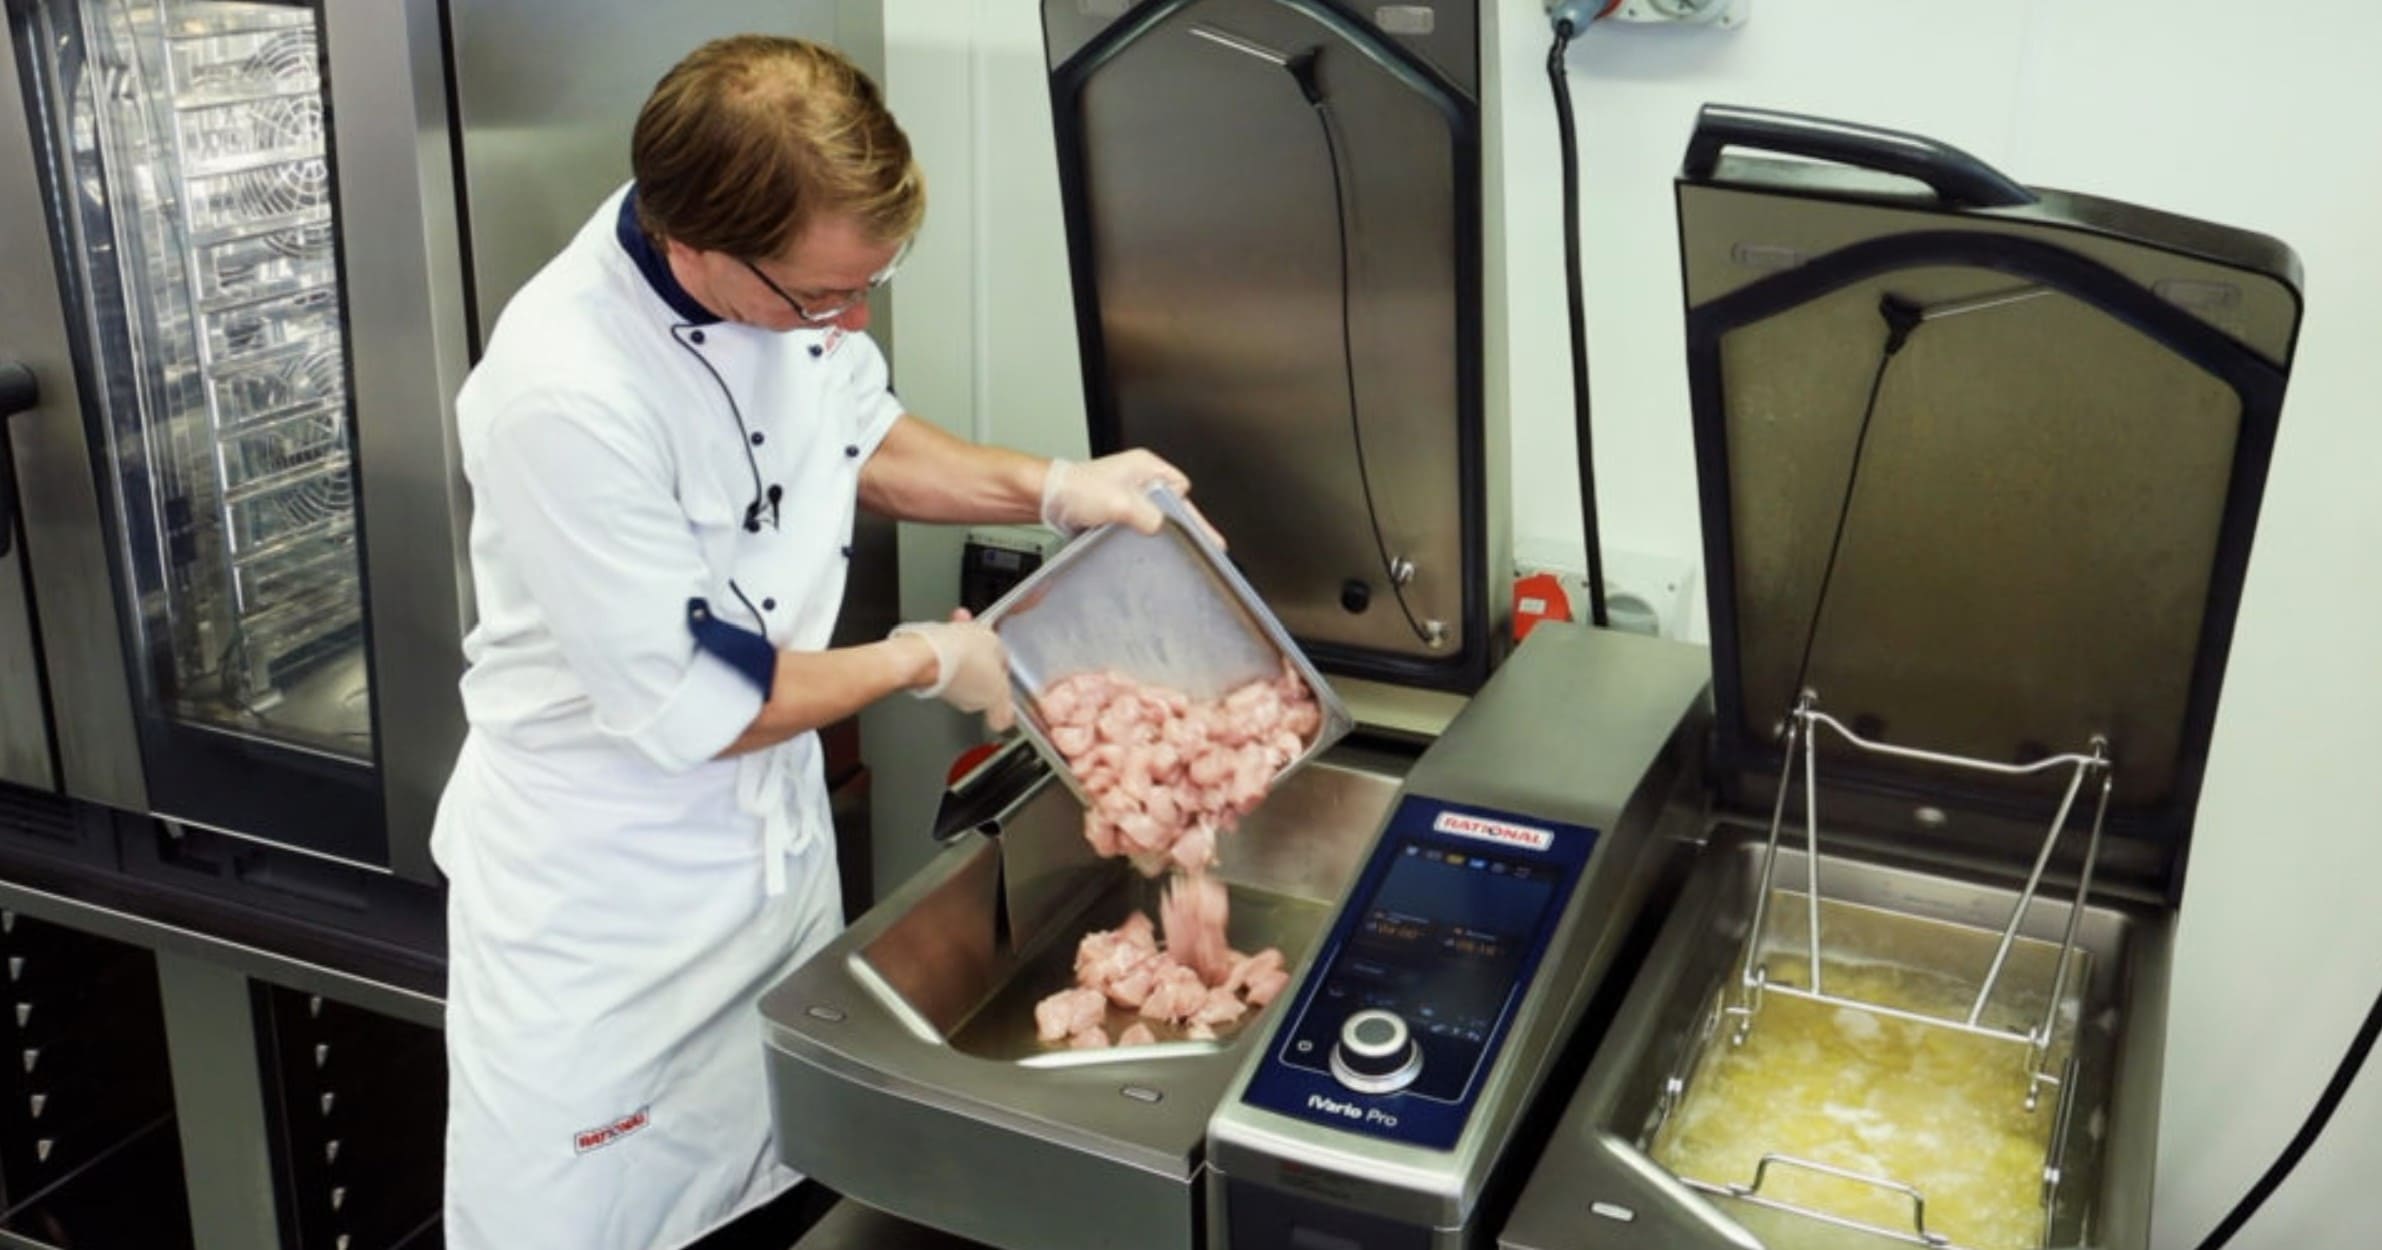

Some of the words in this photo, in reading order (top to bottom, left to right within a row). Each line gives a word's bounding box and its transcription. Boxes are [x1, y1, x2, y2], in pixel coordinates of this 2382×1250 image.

[1444, 817, 1543, 845] RATIONAL
[1308, 1094, 1363, 1119] iVario
[1365, 1107, 1398, 1127] Pro
